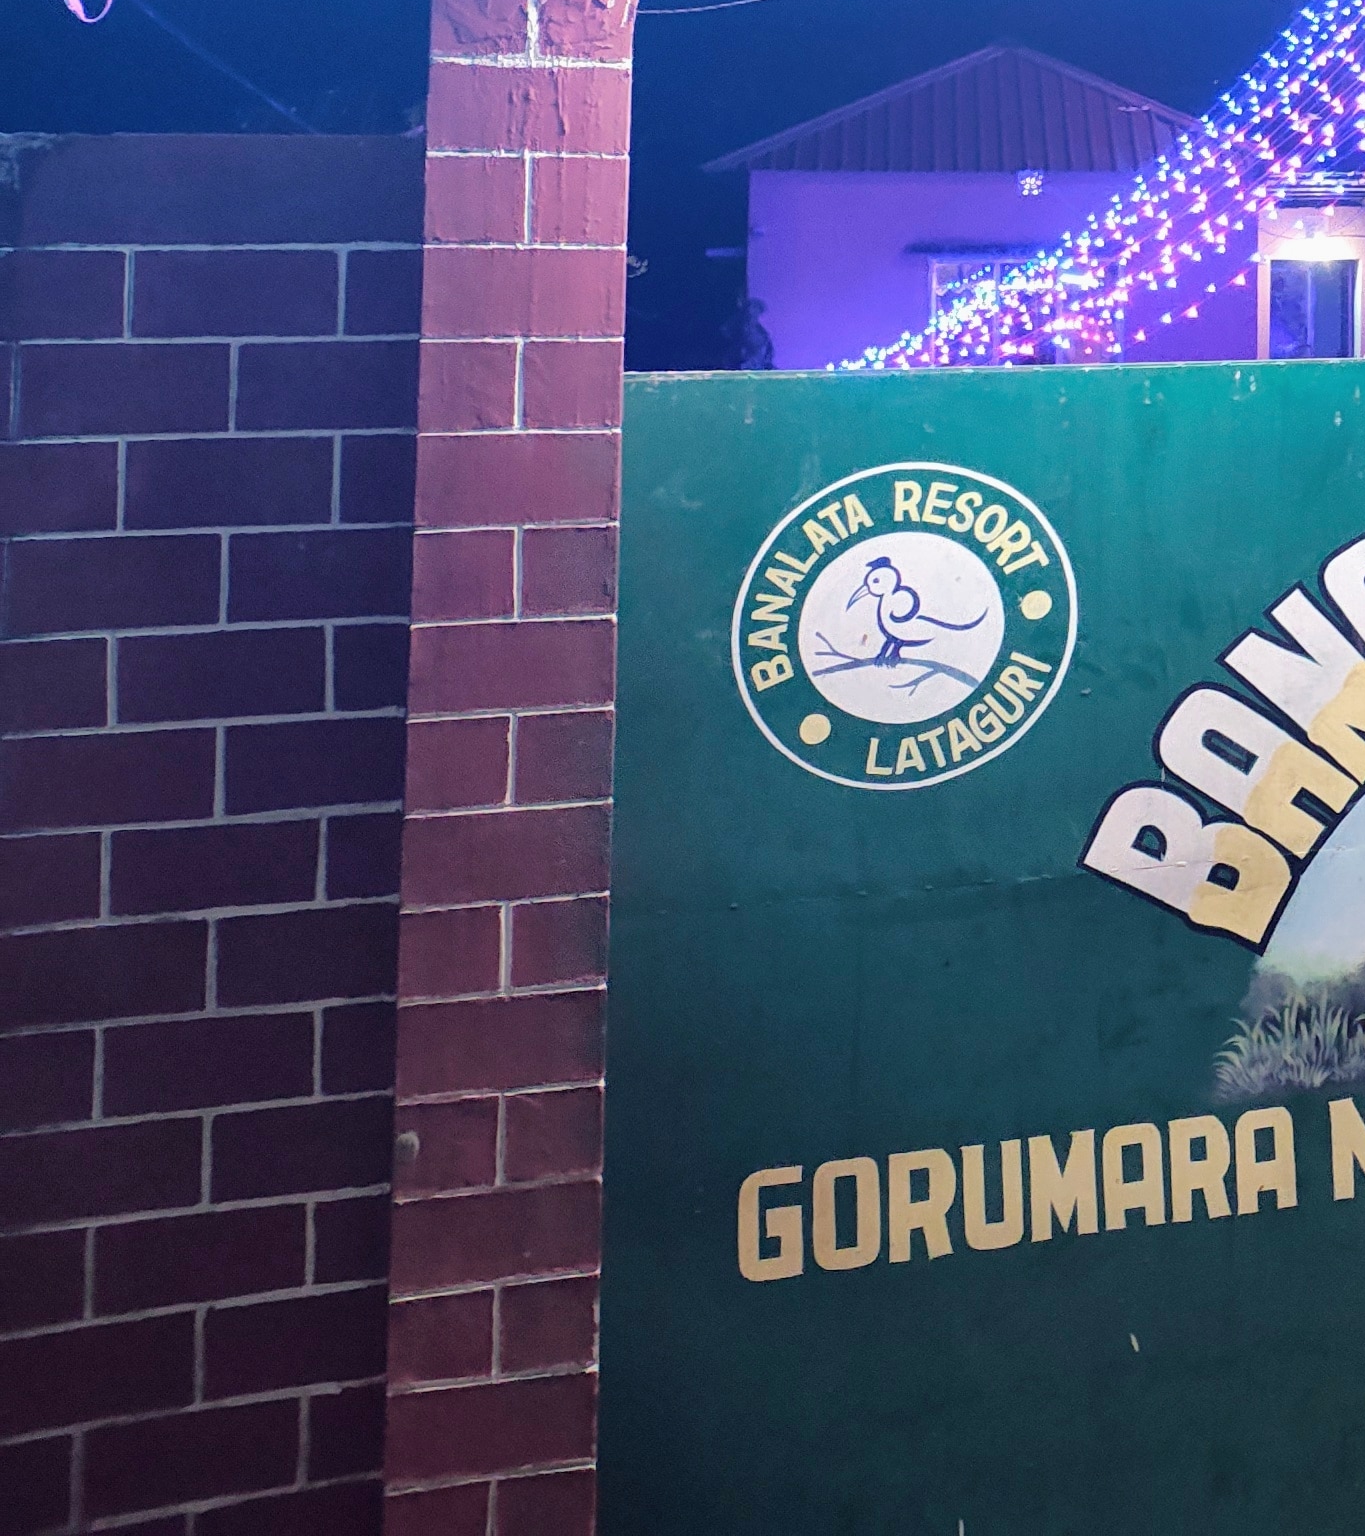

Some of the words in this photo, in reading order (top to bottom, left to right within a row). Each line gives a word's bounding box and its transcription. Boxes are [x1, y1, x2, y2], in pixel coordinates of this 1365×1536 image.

[748, 493, 873, 692] BANALATA
[893, 480, 1049, 575] RESORT
[865, 652, 1052, 775] LATAGURI
[737, 1107, 1298, 1282] GORUMARA
